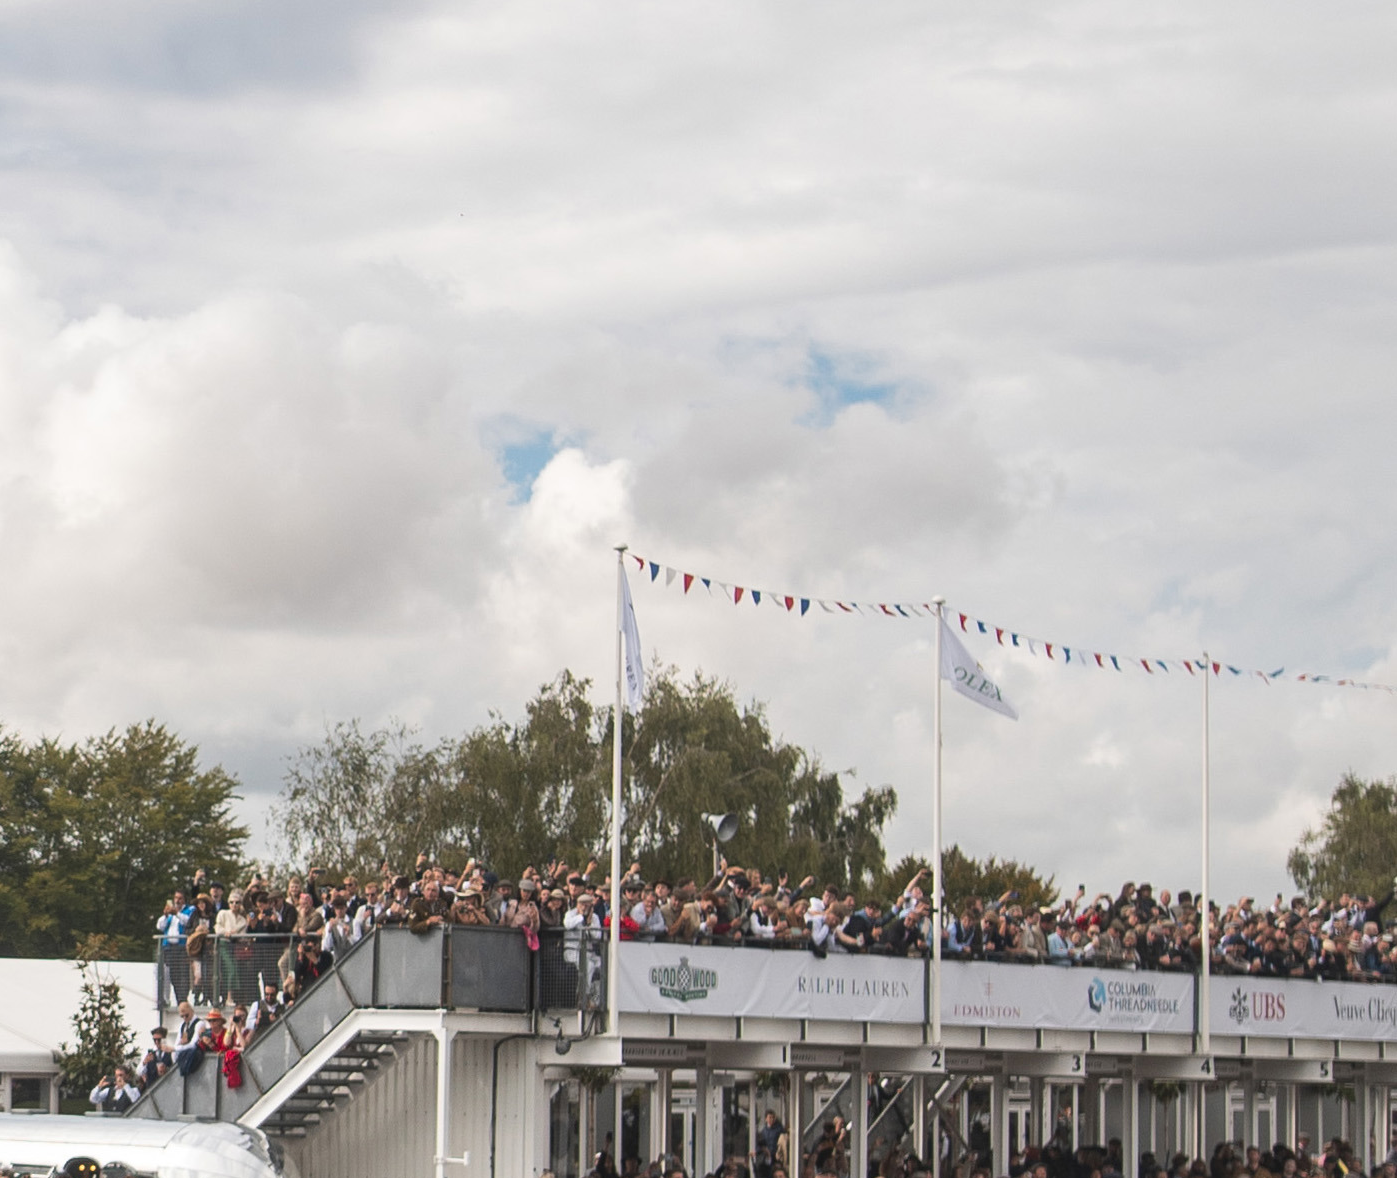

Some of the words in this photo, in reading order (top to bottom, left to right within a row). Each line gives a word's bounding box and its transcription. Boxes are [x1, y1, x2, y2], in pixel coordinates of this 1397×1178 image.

[954, 666, 1003, 702] OLEX
[798, 976, 845, 995] RALPH
[852, 978, 909, 998] LAUREN
[1108, 981, 1156, 996] COLUMBIA
[954, 1005, 1021, 1018] EDMISTON
[1109, 999, 1179, 1014] THREADNEEDLE
[1252, 992, 1286, 1021] UBS
[1334, 995, 1365, 1021] Veuve
[931, 1051, 941, 1068] 2
[1072, 1055, 1081, 1072] 3
[1201, 1060, 1210, 1074] 4
[1320, 1061, 1328, 1077] 5
